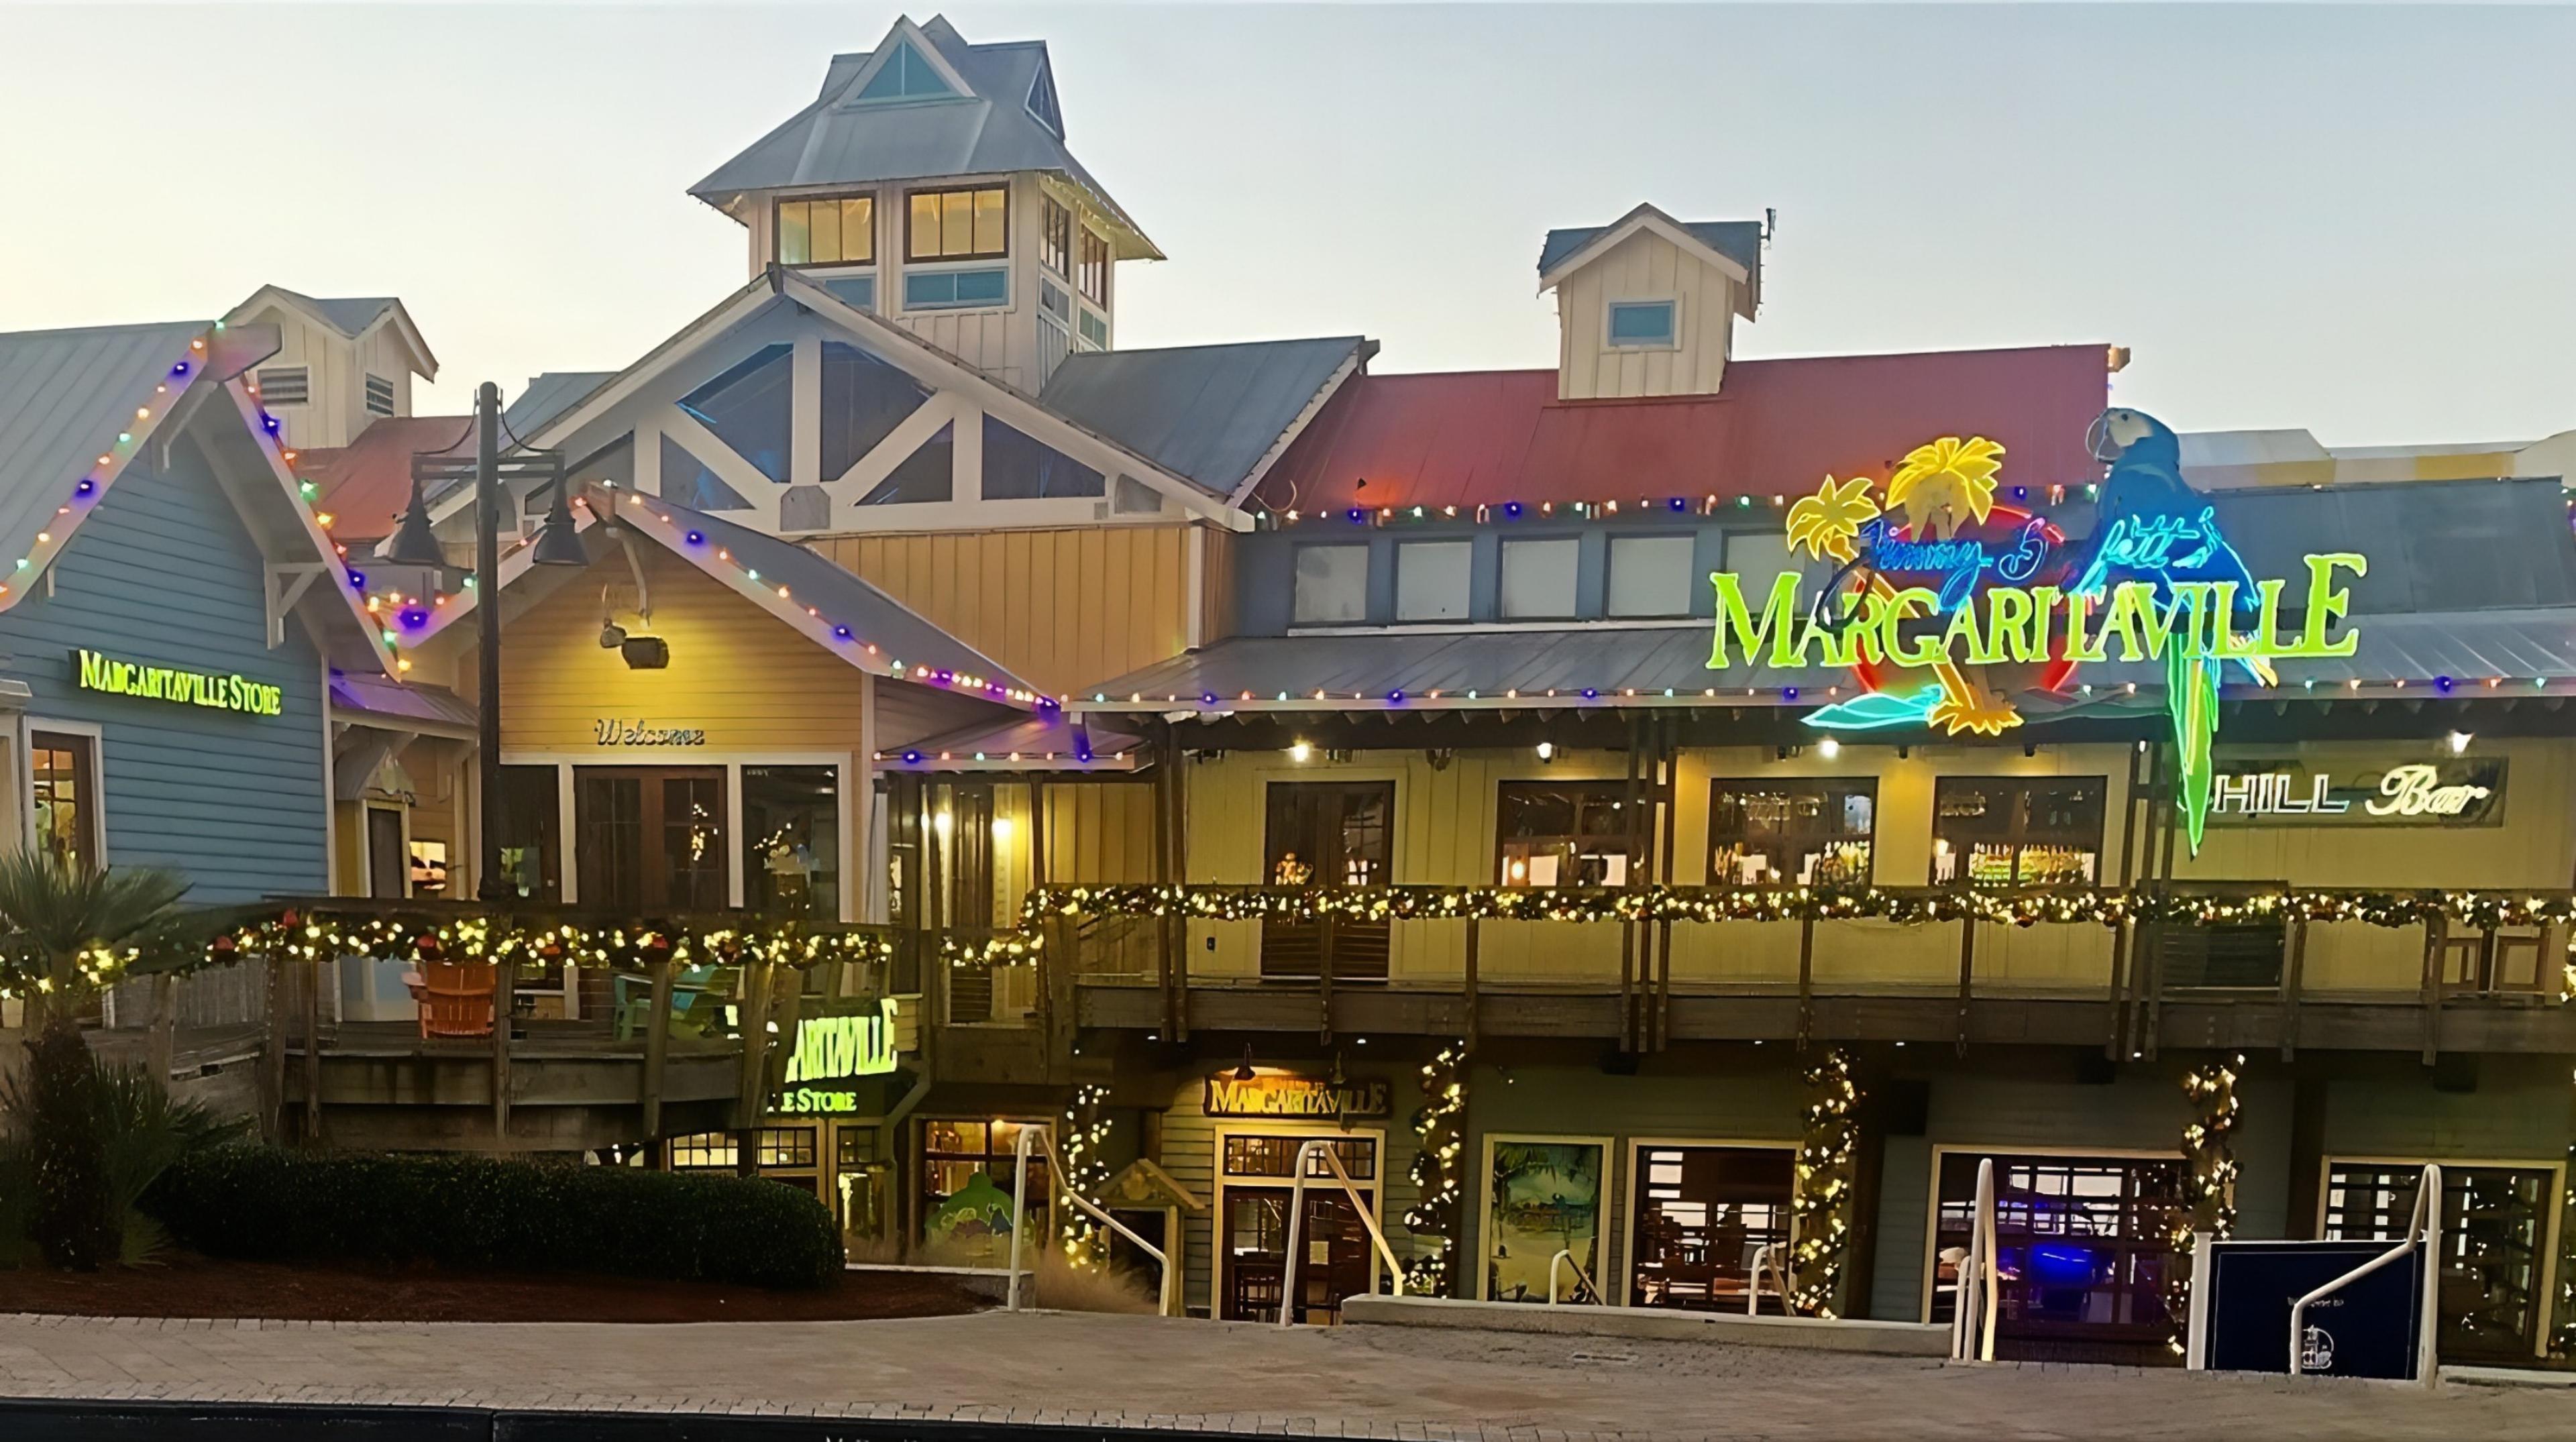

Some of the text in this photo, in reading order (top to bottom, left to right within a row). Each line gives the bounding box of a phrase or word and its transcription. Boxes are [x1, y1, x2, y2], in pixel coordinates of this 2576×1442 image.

[1705, 553, 2367, 669] MARGARITAVILLE
[79, 649, 281, 715] MARGARITAVILLE STORE
[594, 718, 705, 746] Welcome
[2176, 763, 2490, 816] HILL Bar
[796, 1087, 857, 1113] STORE
[1210, 1078, 1387, 1115] MARGARITAVILLE
